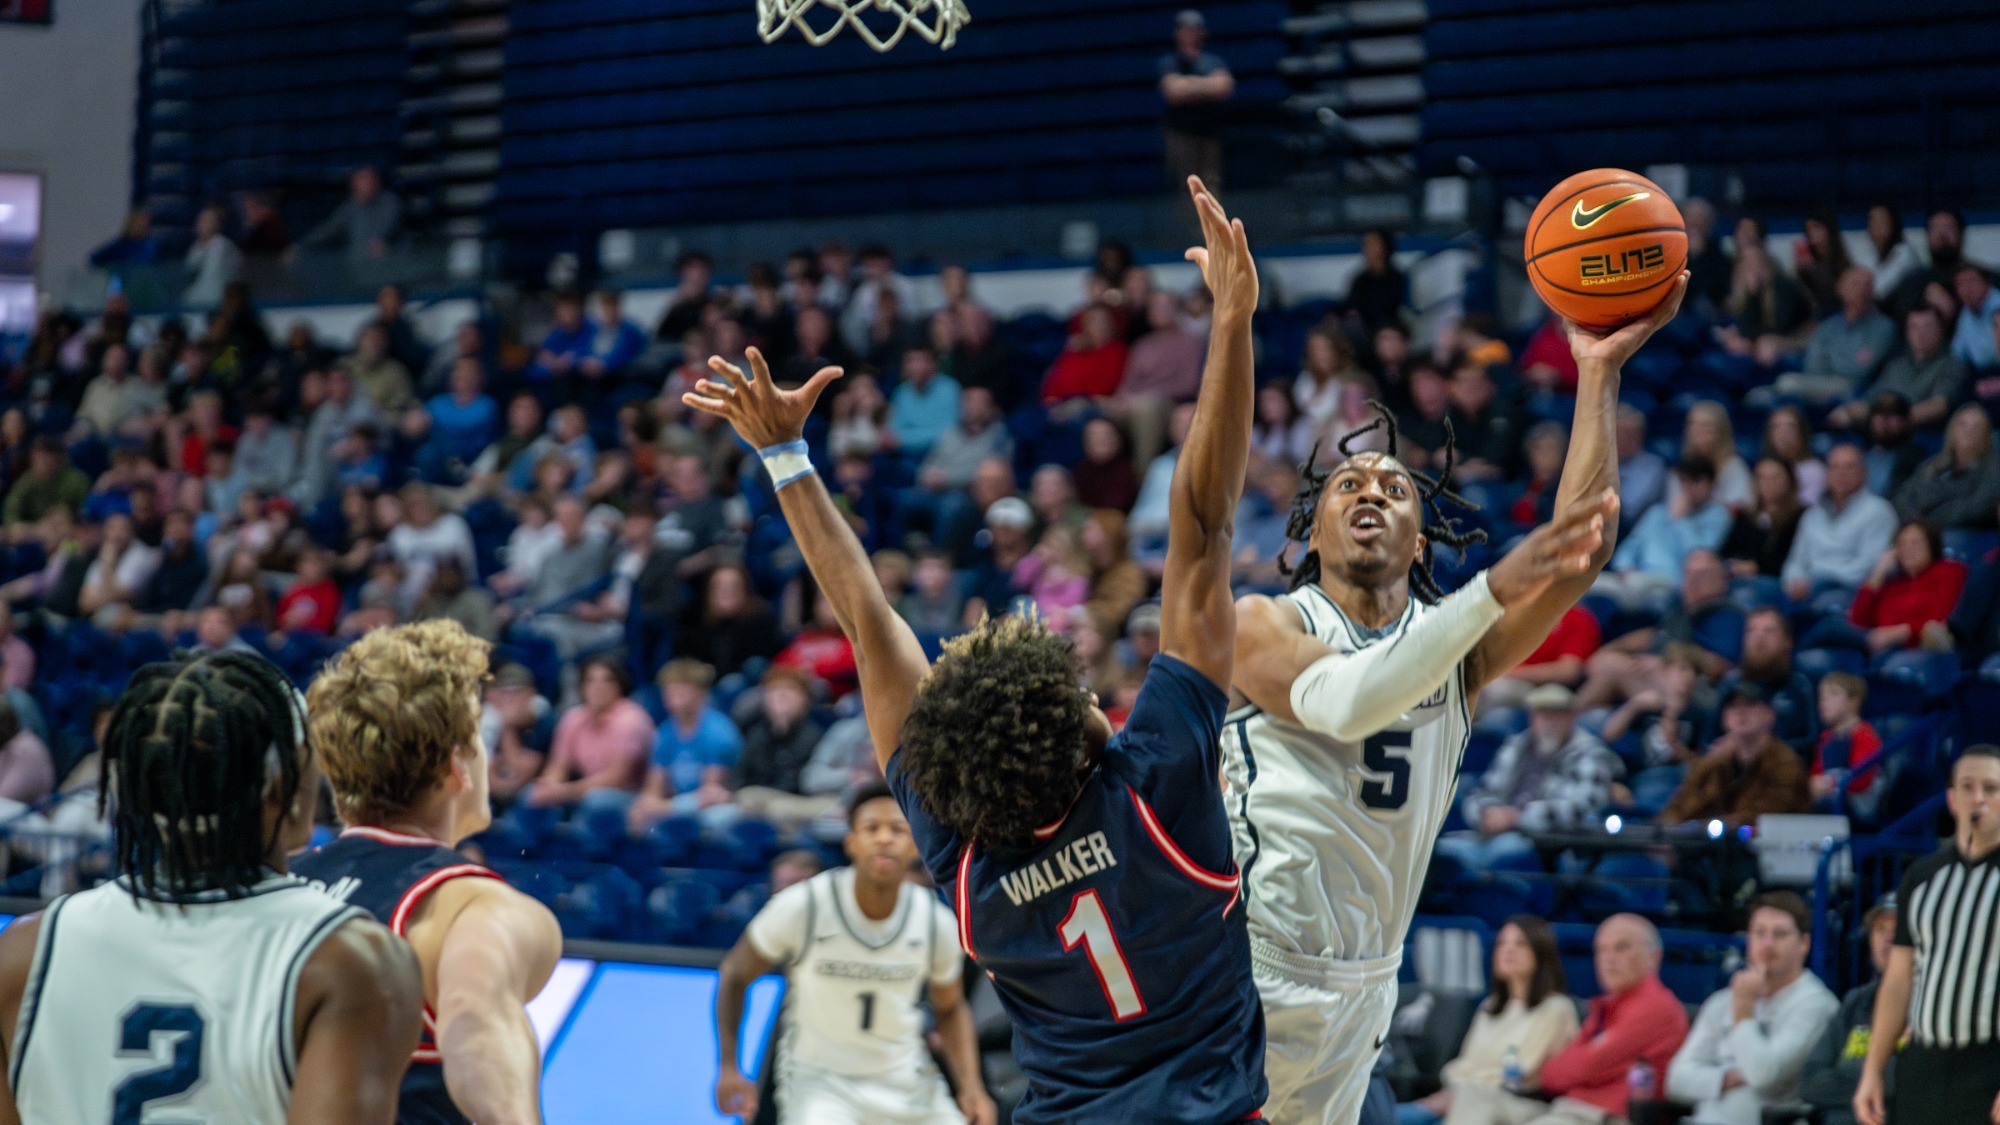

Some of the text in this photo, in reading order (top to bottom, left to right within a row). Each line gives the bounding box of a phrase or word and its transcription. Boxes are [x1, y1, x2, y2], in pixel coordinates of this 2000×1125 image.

[1580, 243, 1665, 278] ELITE
[1359, 730, 1413, 810] 5
[1000, 830, 1118, 906] WALKER
[1056, 887, 1147, 1022] 1
[856, 990, 876, 1031] 1
[109, 998, 210, 1125] 2
